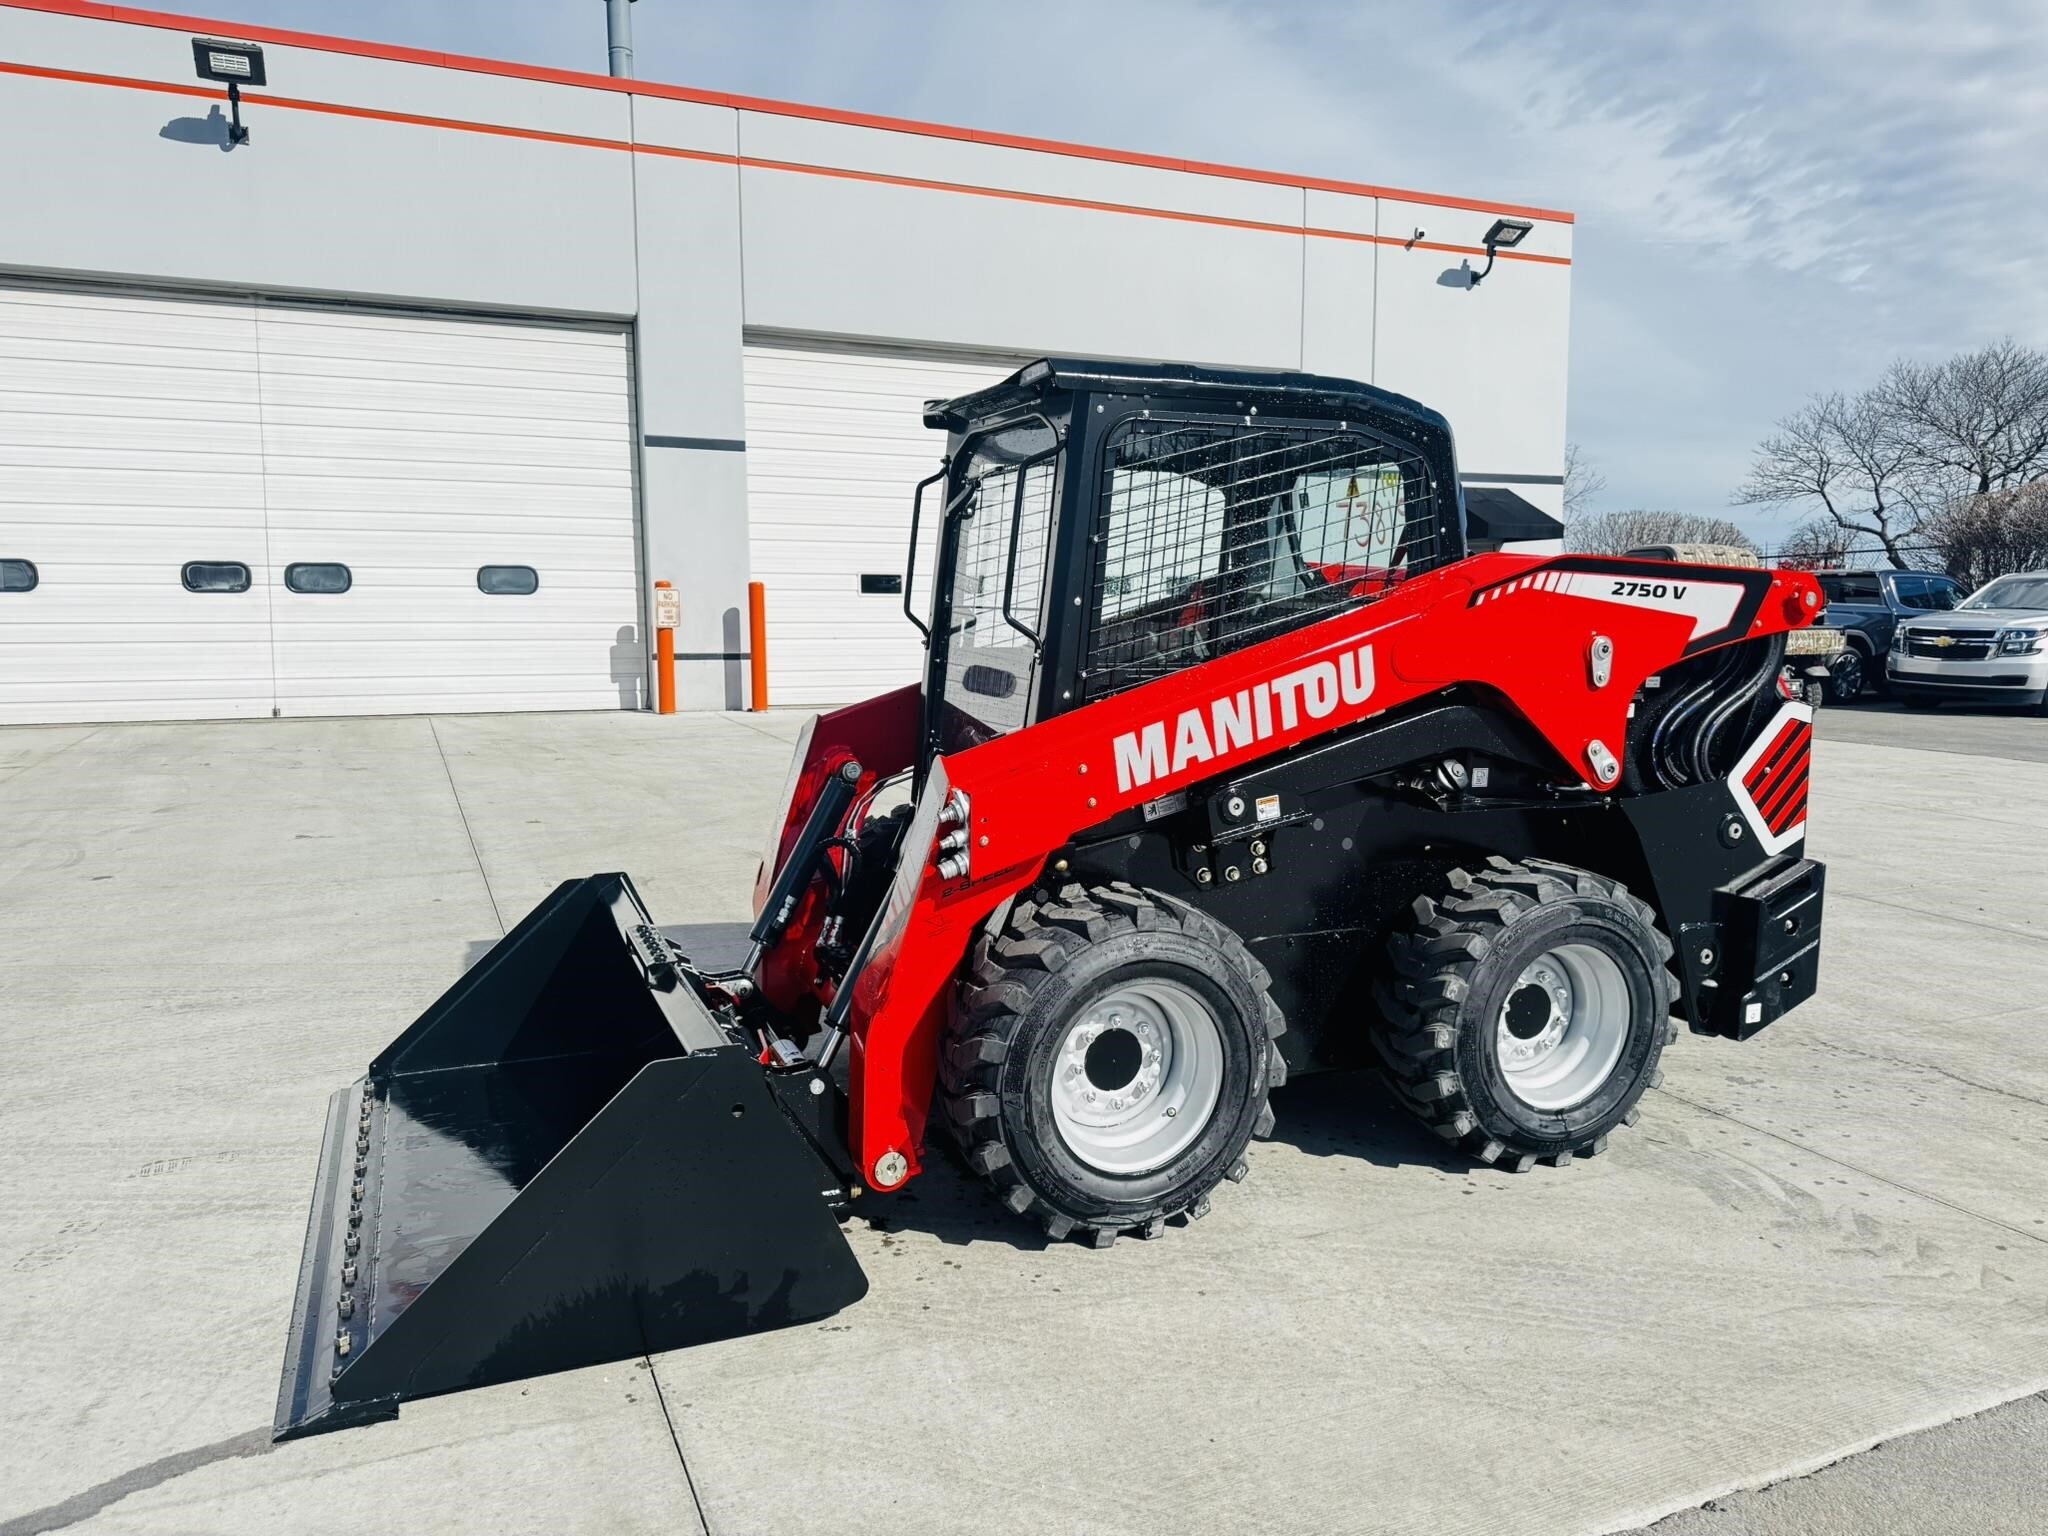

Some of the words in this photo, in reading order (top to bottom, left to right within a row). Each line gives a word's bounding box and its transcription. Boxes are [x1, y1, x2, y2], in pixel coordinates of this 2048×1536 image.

[1611, 582, 1667, 599] 2750
[1673, 586, 1687, 600] V
[1113, 643, 1376, 793] MANITOU
